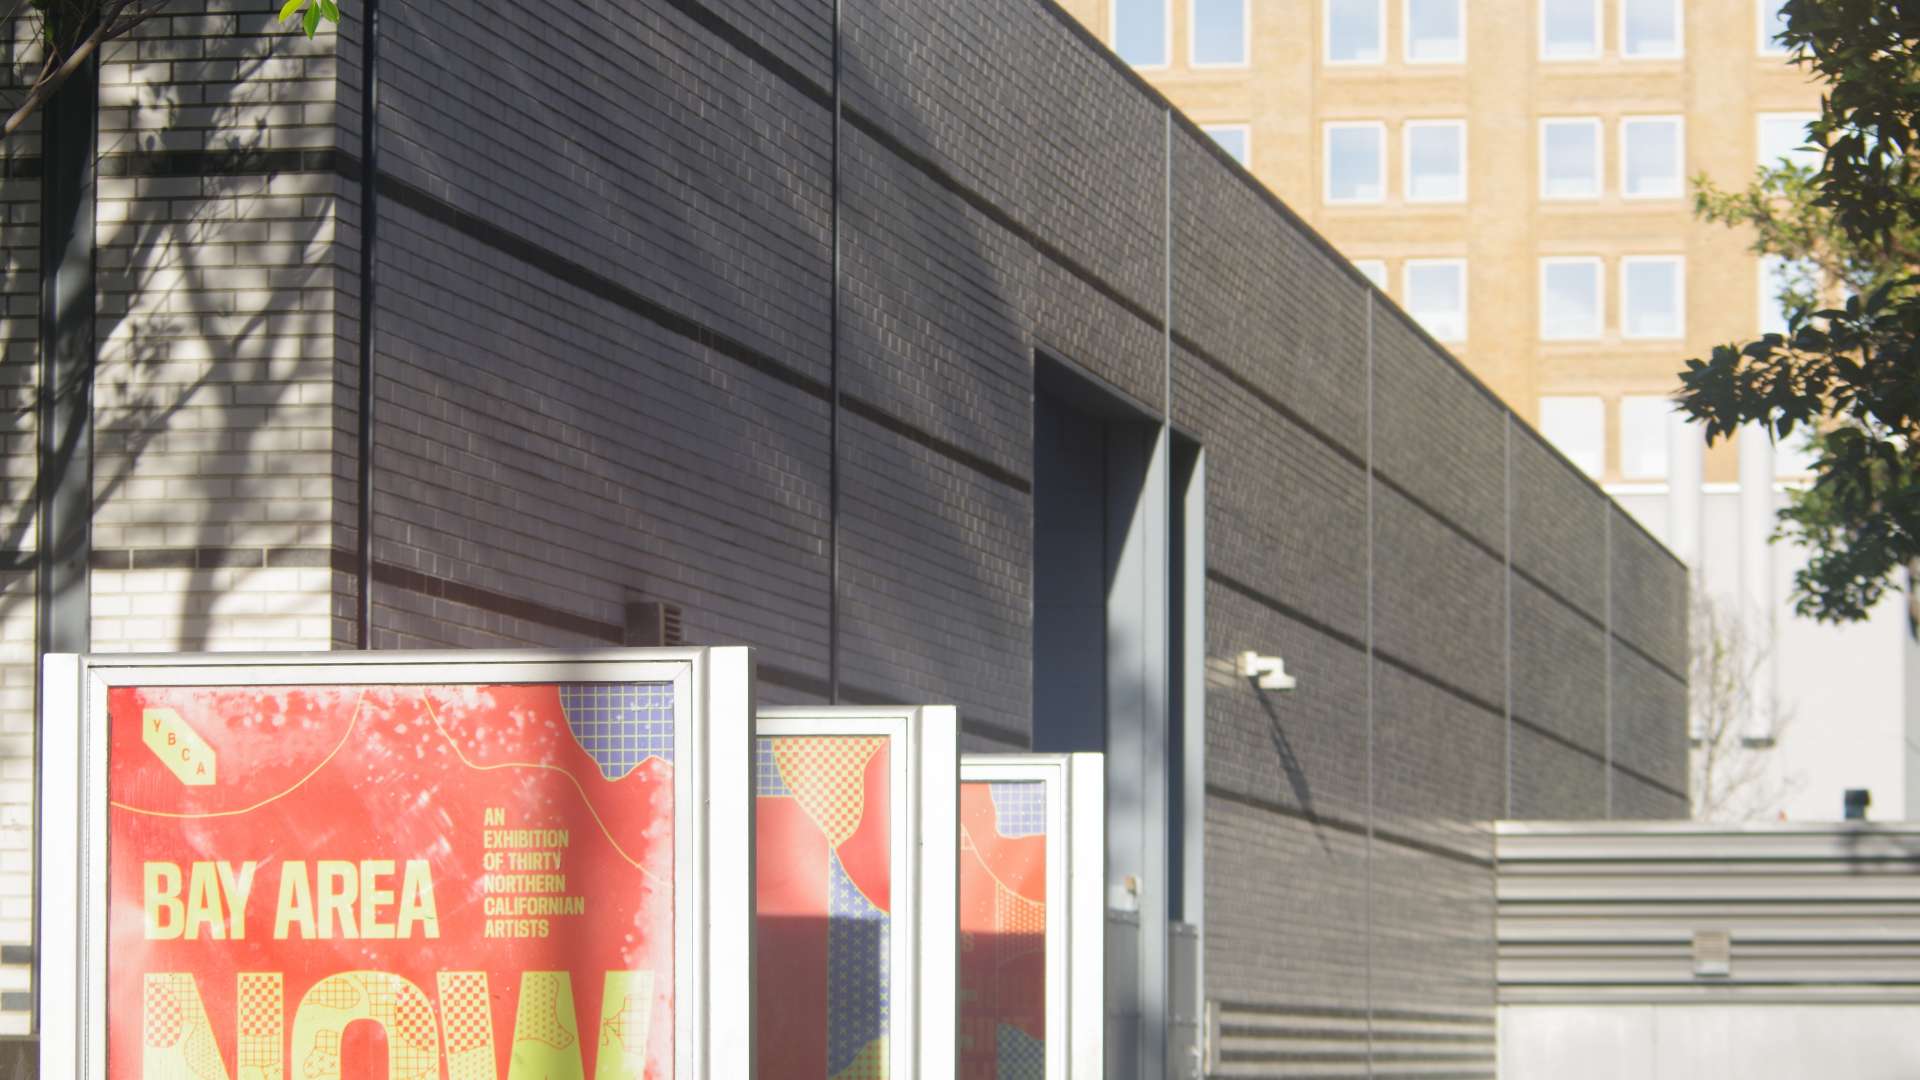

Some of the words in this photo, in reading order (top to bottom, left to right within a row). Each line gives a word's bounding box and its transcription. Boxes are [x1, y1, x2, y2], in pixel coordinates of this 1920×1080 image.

[153, 719, 206, 775] YBCA
[484, 807, 505, 827] AN
[484, 829, 569, 849] EXHIBITION
[484, 851, 504, 871] OF
[508, 851, 562, 871] THIRTY
[484, 873, 566, 893] NORTHERN
[143, 860, 257, 941] BAY
[273, 859, 440, 940] AREA
[484, 896, 585, 916] CALIFORNIAN
[484, 918, 550, 939] ARTISTS
